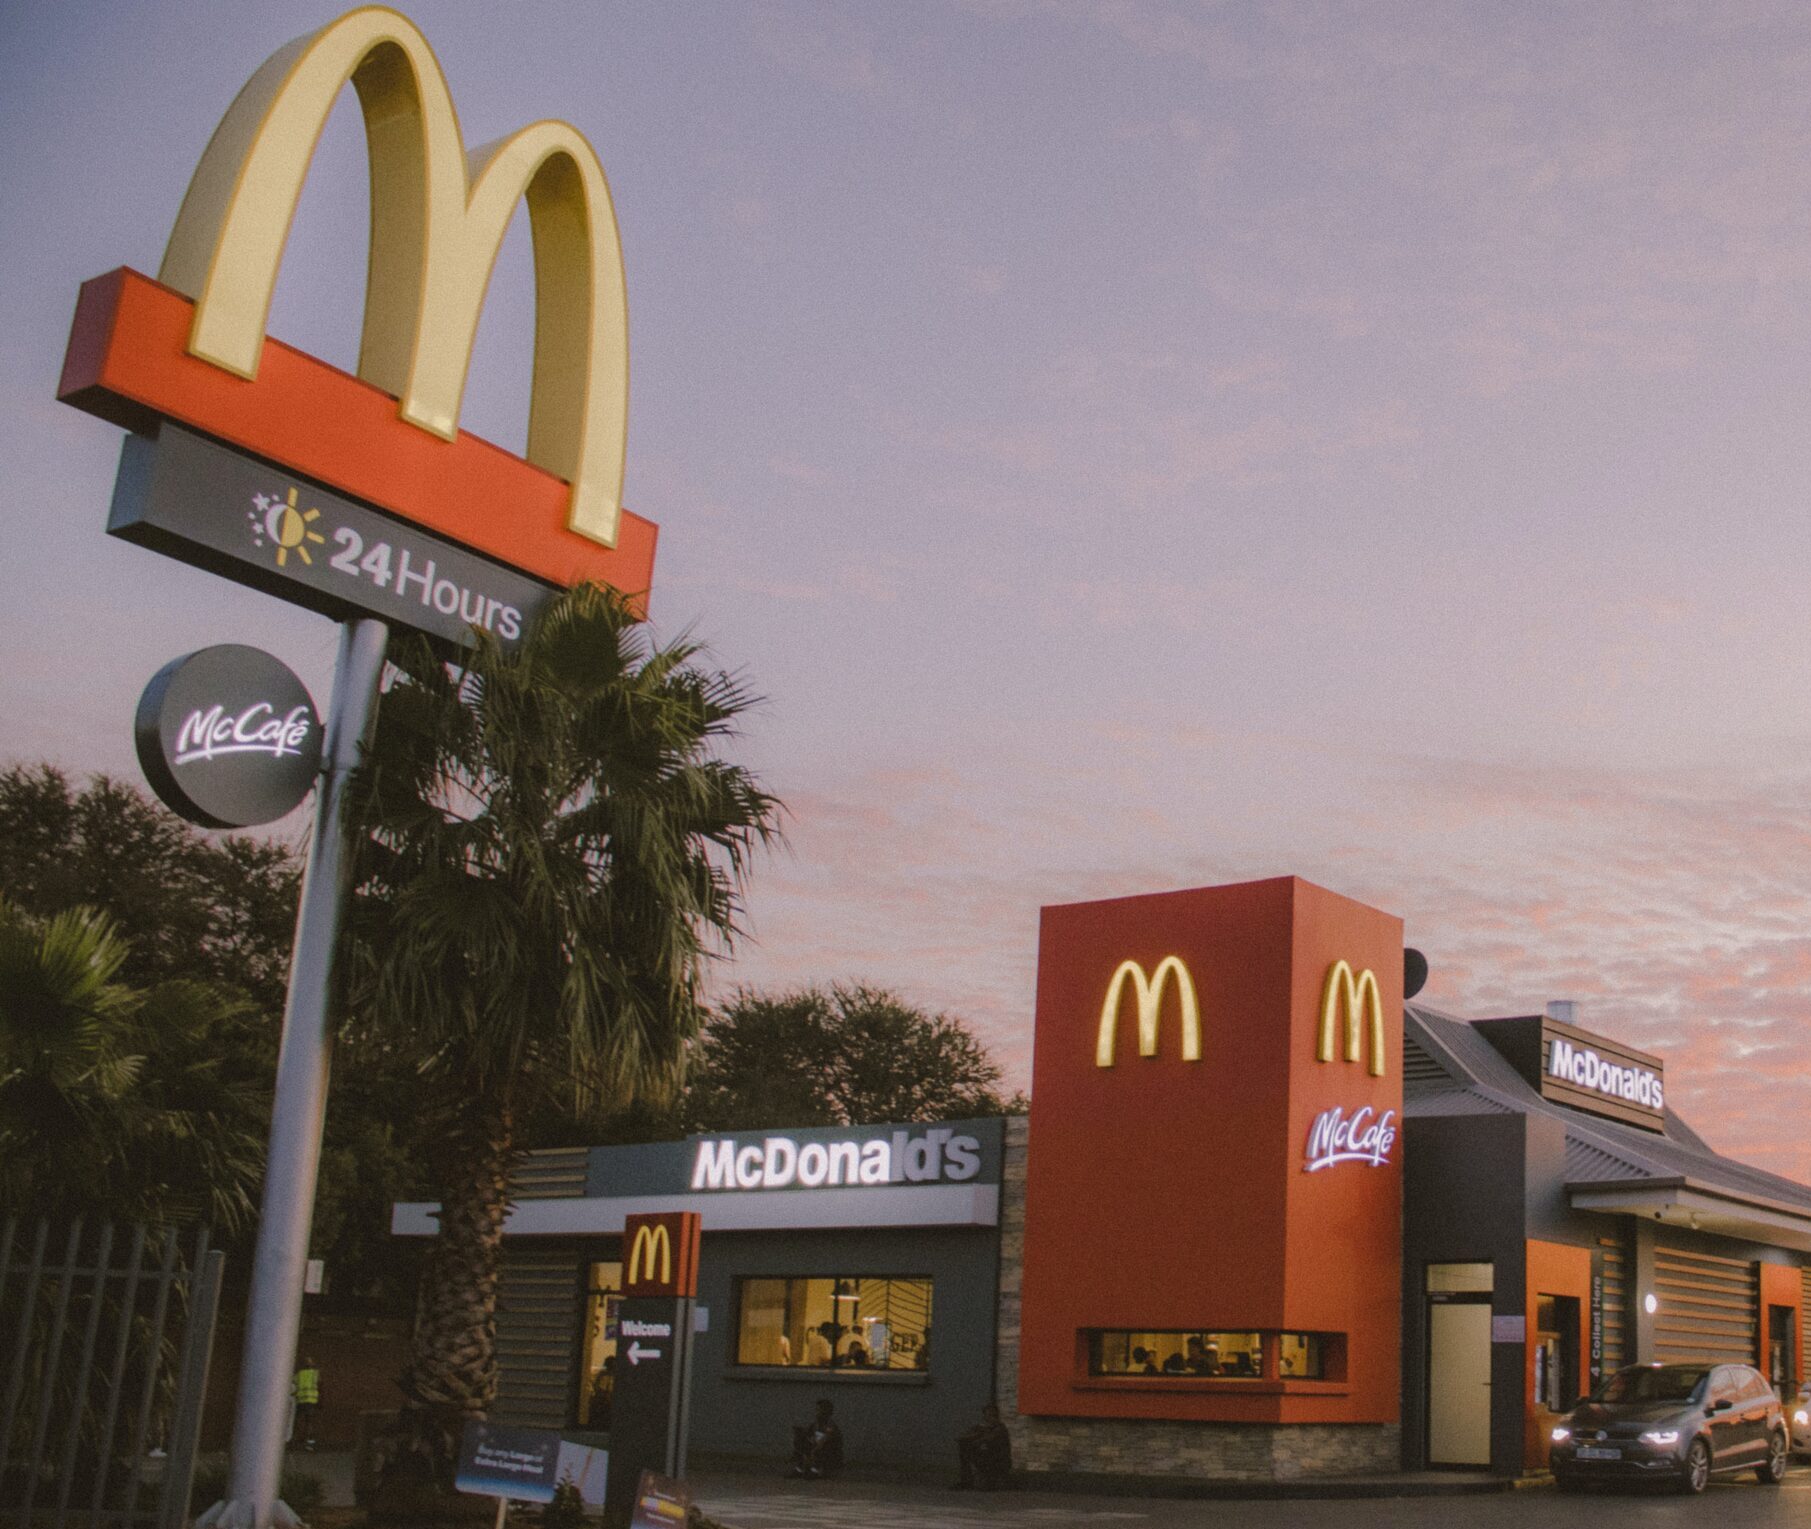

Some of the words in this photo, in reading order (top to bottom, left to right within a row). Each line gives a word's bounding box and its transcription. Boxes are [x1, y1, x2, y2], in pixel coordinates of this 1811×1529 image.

[329, 526, 393, 588] 24
[395, 549, 523, 641] Hours
[175, 702, 311, 766] McCafé
[1549, 1039, 1663, 1109] McDonald's
[690, 1128, 981, 1191] McDonald's
[1303, 1105, 1396, 1173] McCafé
[1592, 1276, 1601, 1308] Here
[621, 1320, 671, 1337] Welcome
[1592, 1311, 1601, 1360] Collect
